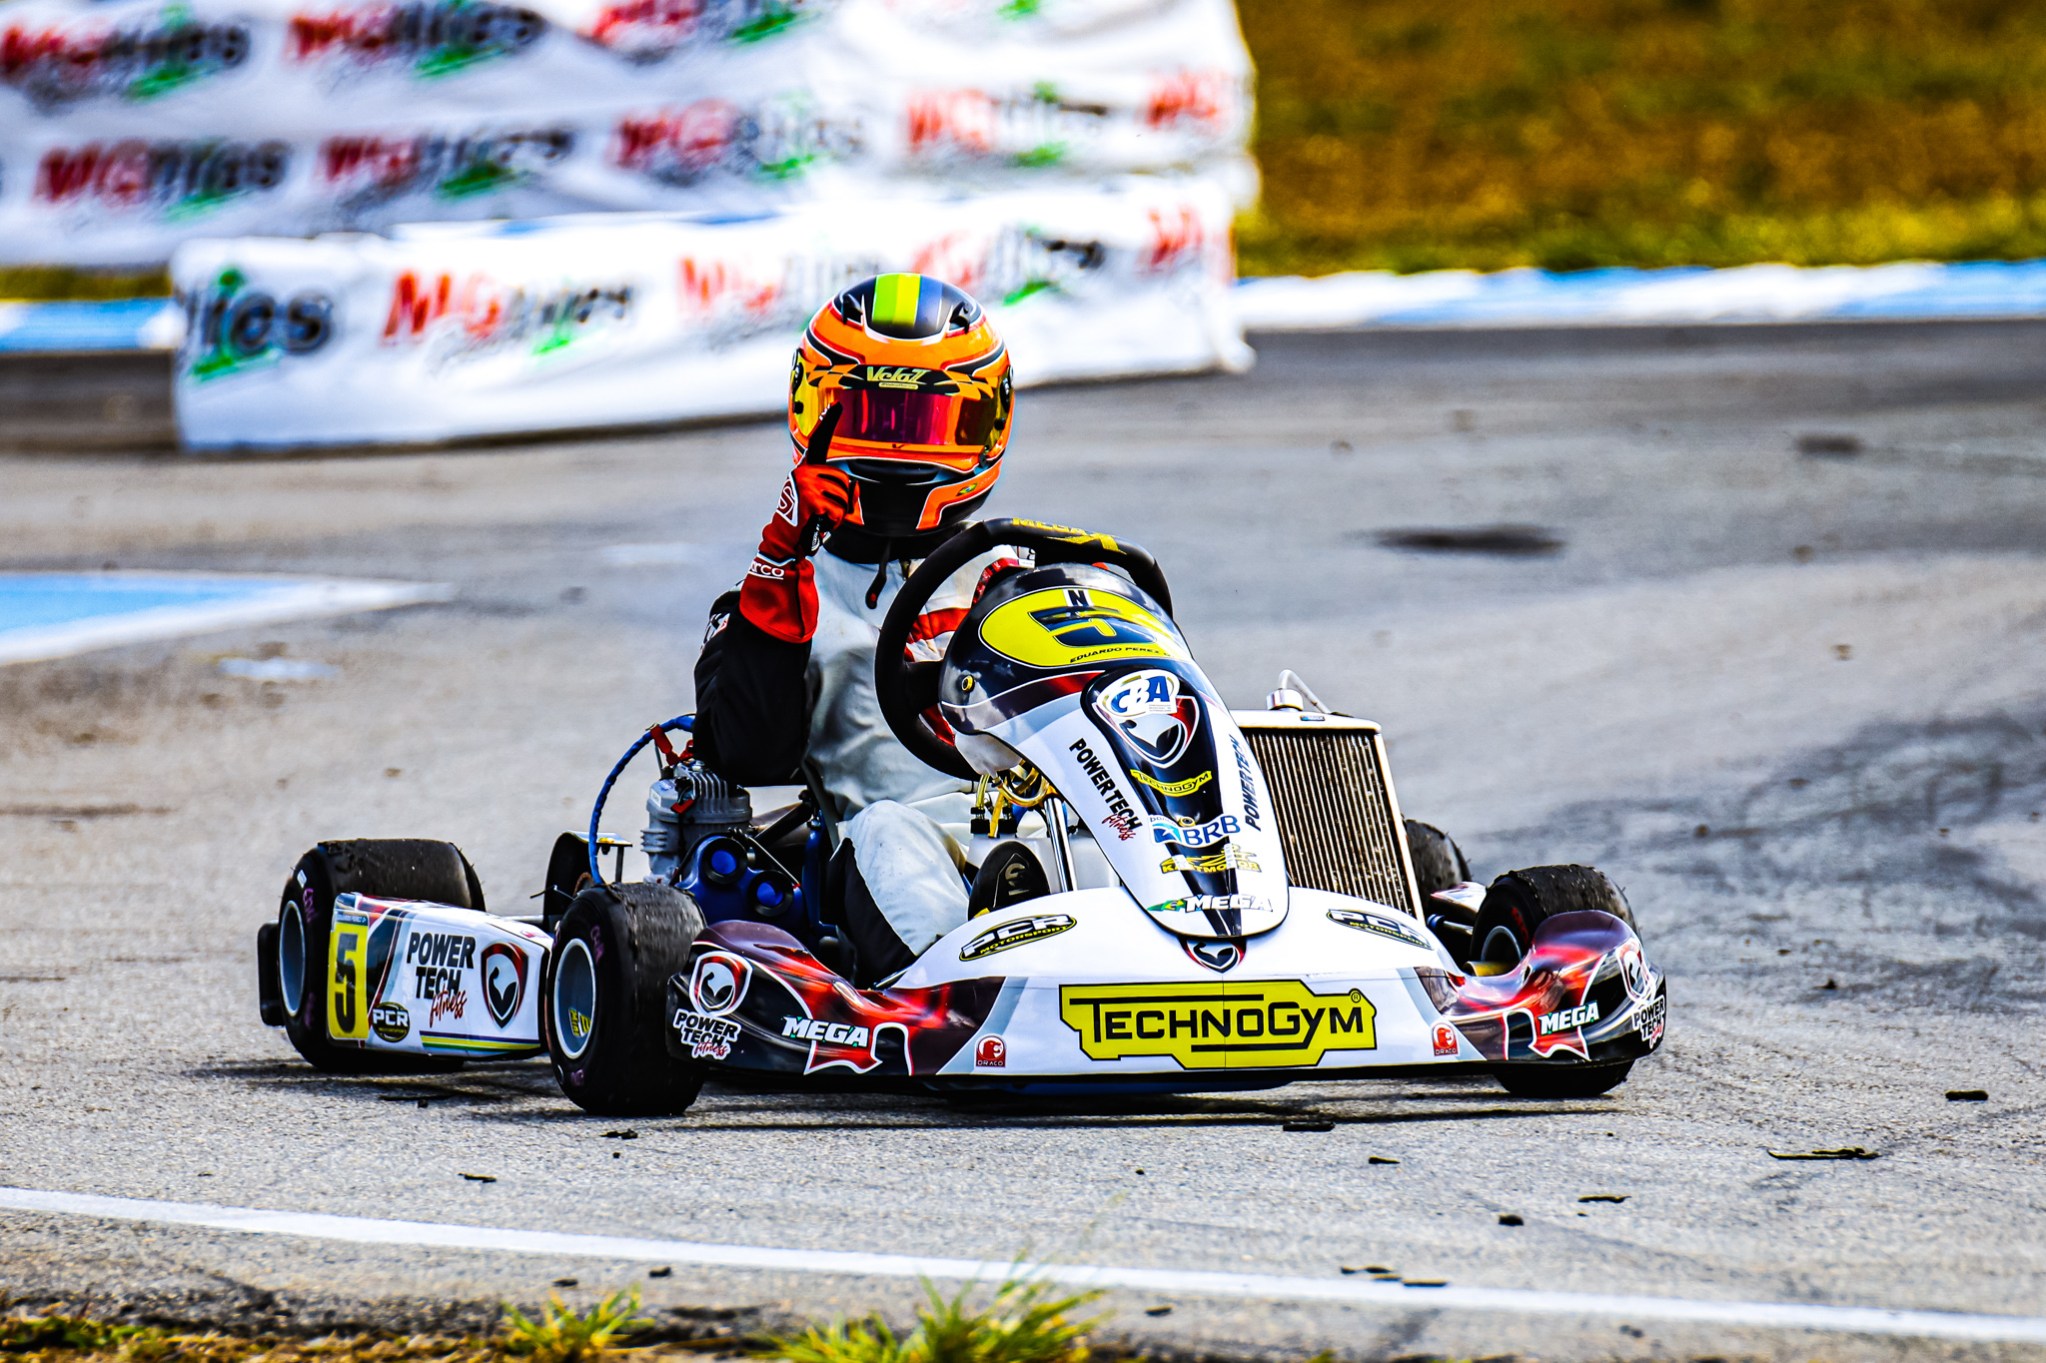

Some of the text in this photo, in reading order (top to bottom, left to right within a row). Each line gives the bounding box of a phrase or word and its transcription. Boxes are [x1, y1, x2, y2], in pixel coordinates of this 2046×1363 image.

[1069, 647, 1122, 663] EDUARDO
[1111, 675, 1170, 713] CBA
[1182, 815, 1240, 846] BRB
[1184, 894, 1273, 913] MEGA
[406, 932, 477, 969] POWER
[962, 915, 1072, 957] PCR
[334, 932, 358, 1034] 5
[415, 966, 462, 1000] TECH
[373, 1009, 409, 1027] PCR
[675, 1012, 739, 1039] POWER
[1538, 1001, 1600, 1035] MEGA
[1633, 998, 1665, 1027] POWER
[683, 1027, 725, 1046] TECH
[781, 1016, 869, 1048] MEGA
